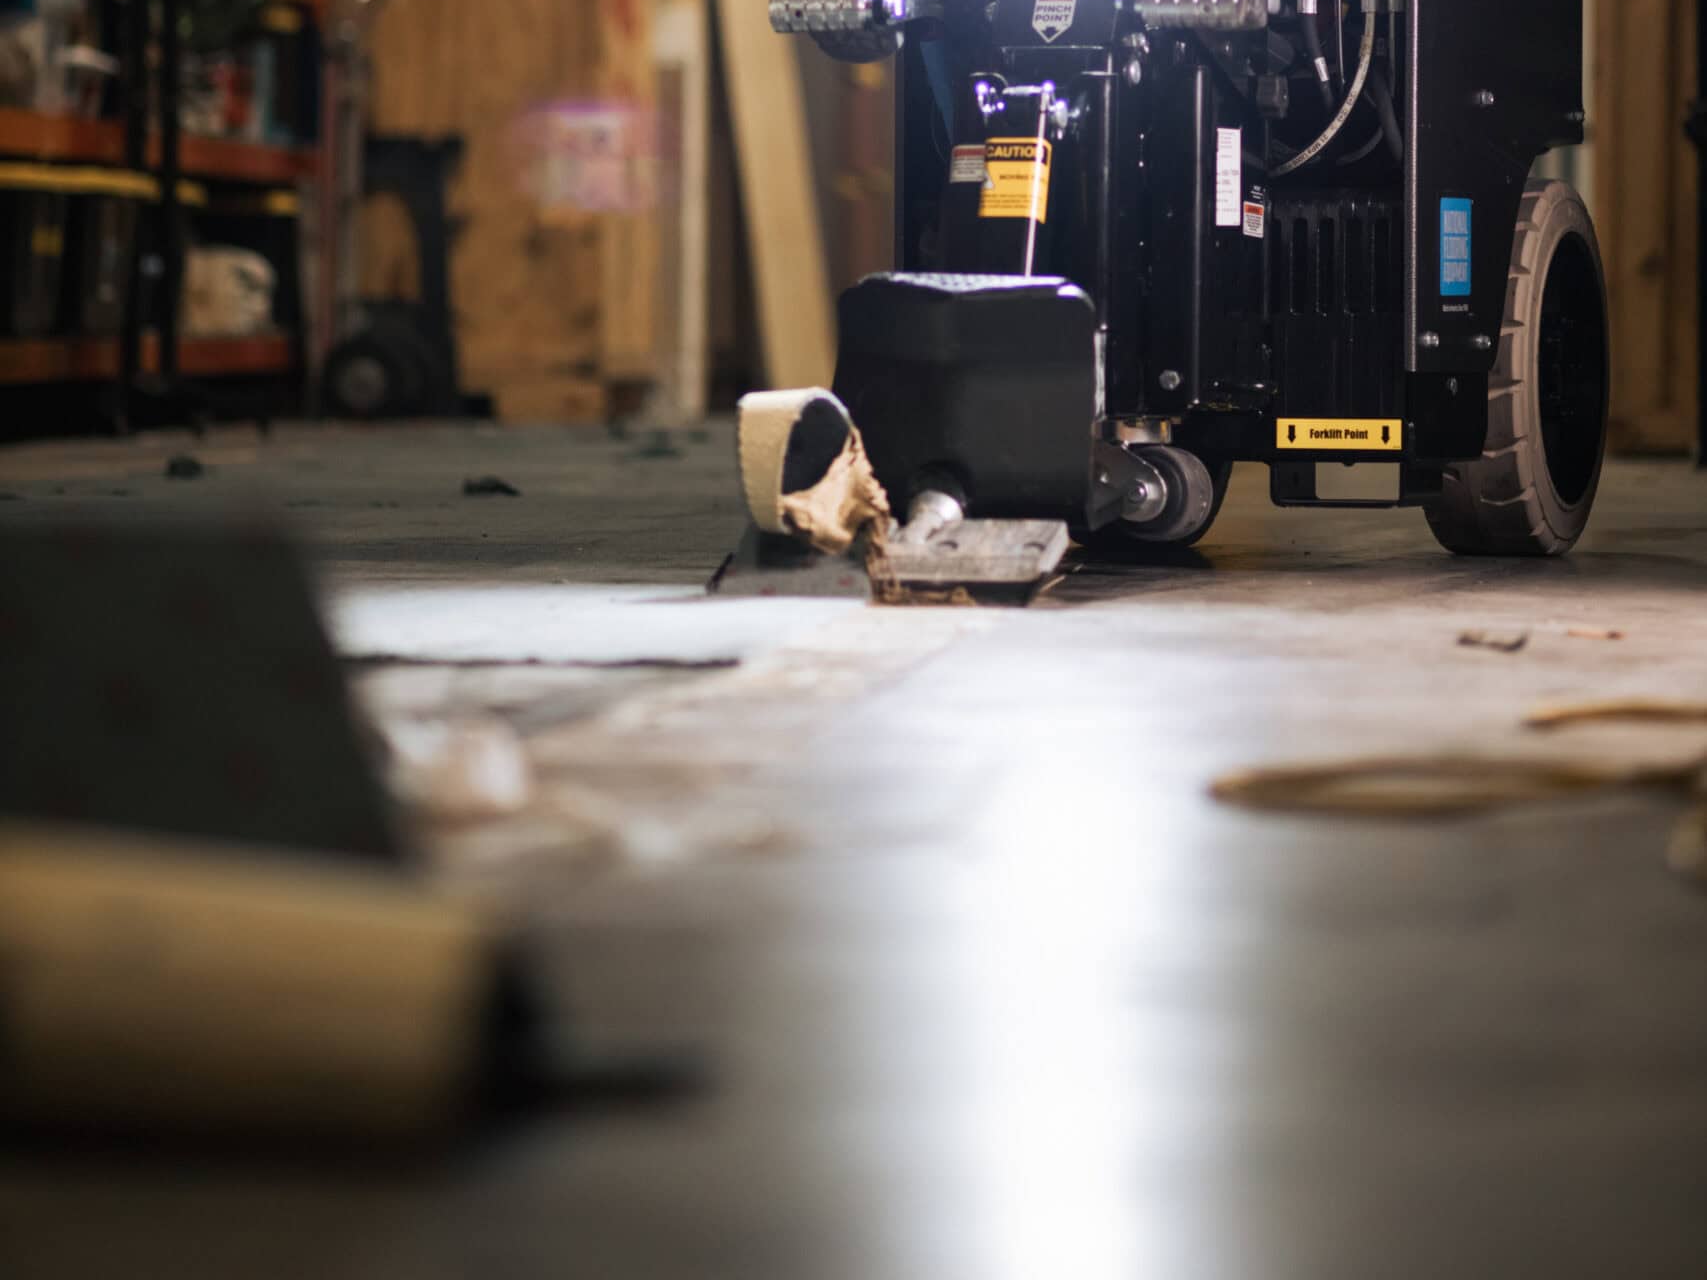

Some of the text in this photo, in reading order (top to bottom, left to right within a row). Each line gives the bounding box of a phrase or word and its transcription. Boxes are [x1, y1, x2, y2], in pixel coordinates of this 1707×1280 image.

[1036, 5, 1072, 13] PINCH
[1035, 14, 1070, 22] POINT
[986, 145, 1044, 158] CAUTIO
[1309, 428, 1369, 440] Forklift Point
